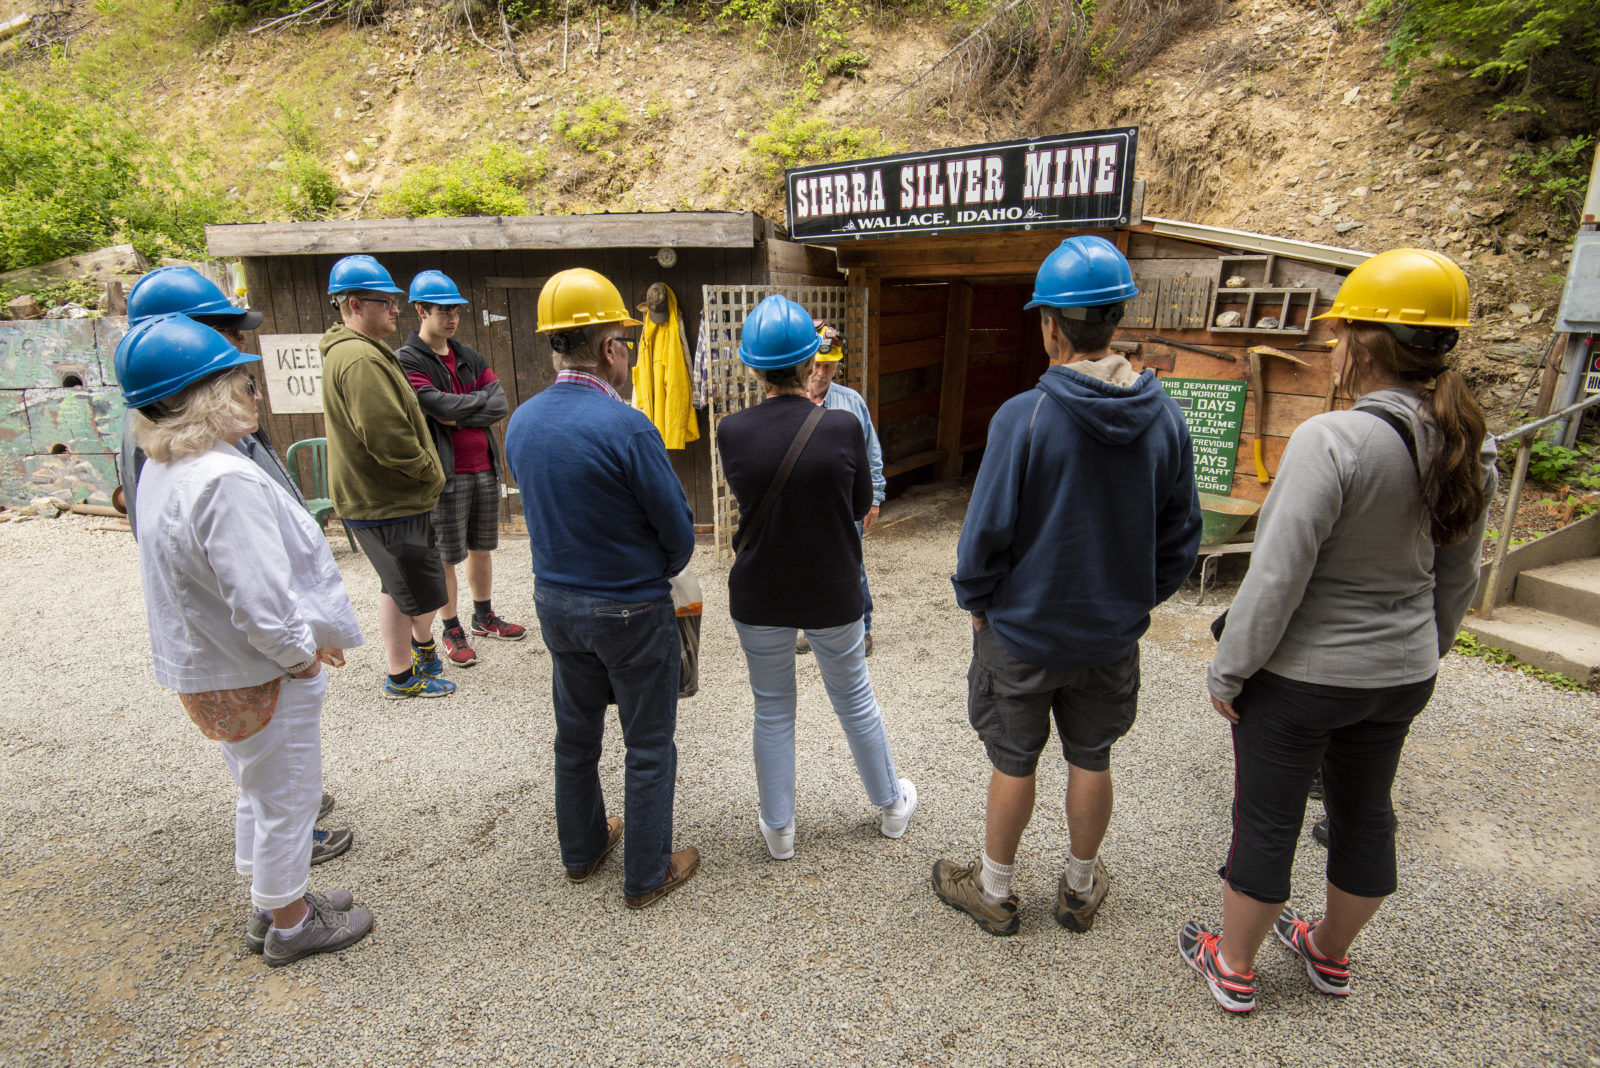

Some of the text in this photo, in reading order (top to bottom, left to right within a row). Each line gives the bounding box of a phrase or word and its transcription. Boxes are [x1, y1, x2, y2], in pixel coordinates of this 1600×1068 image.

[796, 143, 1118, 217] SIERRA SILVER MINE
[858, 206, 1023, 229] WALLACE, IDAHO
[1183, 382, 1243, 392] DEPARTMENT
[1191, 390, 1229, 399] WORKED
[1197, 398, 1237, 412] DAYS
[1184, 410, 1225, 419] THOUT
[1206, 419, 1236, 428] TIME
[1189, 426, 1227, 435] IDENT
[1193, 438, 1234, 449] PREVIOUS
[1200, 446, 1218, 455] WAS
[1201, 466, 1231, 476] PART
[1196, 481, 1228, 491] CORD
